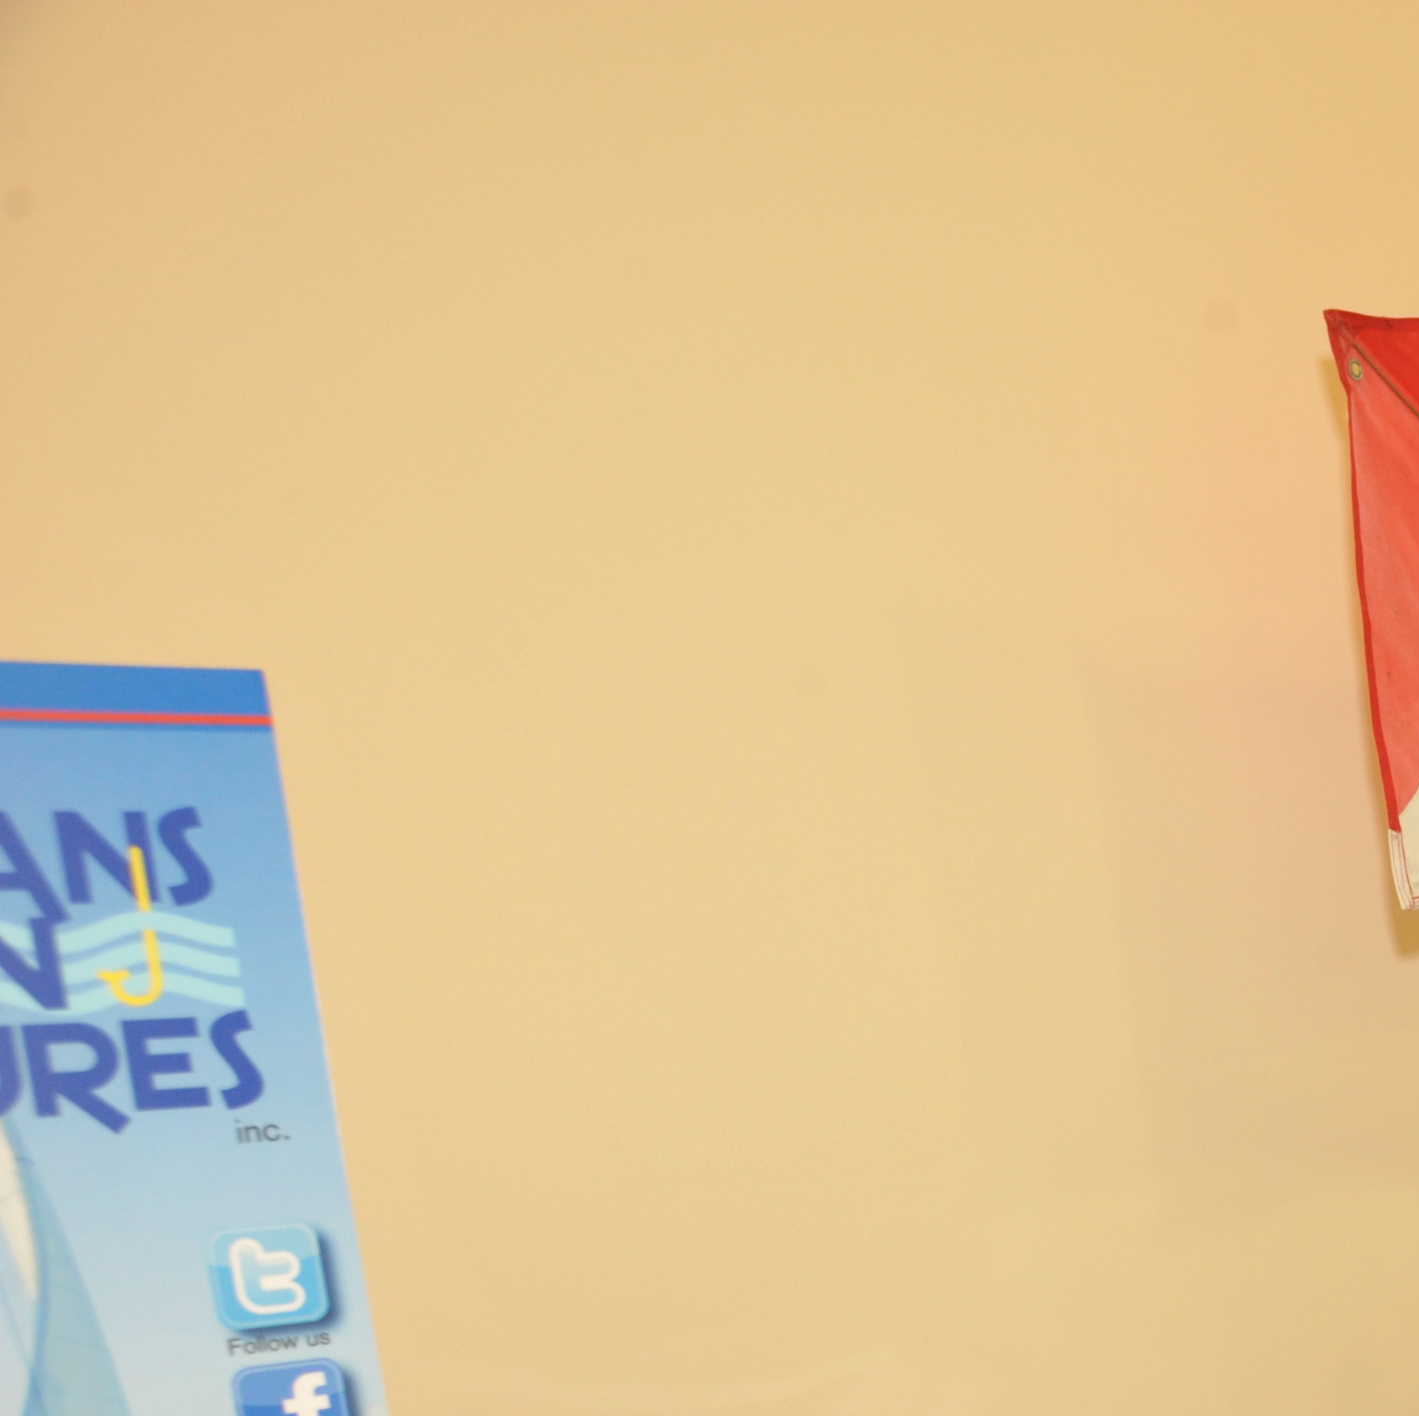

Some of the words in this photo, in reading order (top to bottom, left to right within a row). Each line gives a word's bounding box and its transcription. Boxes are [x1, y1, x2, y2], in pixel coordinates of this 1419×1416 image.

[235, 1119, 291, 1144] inc.
[227, 1334, 299, 1357] Follow
[306, 1330, 331, 1347] us
